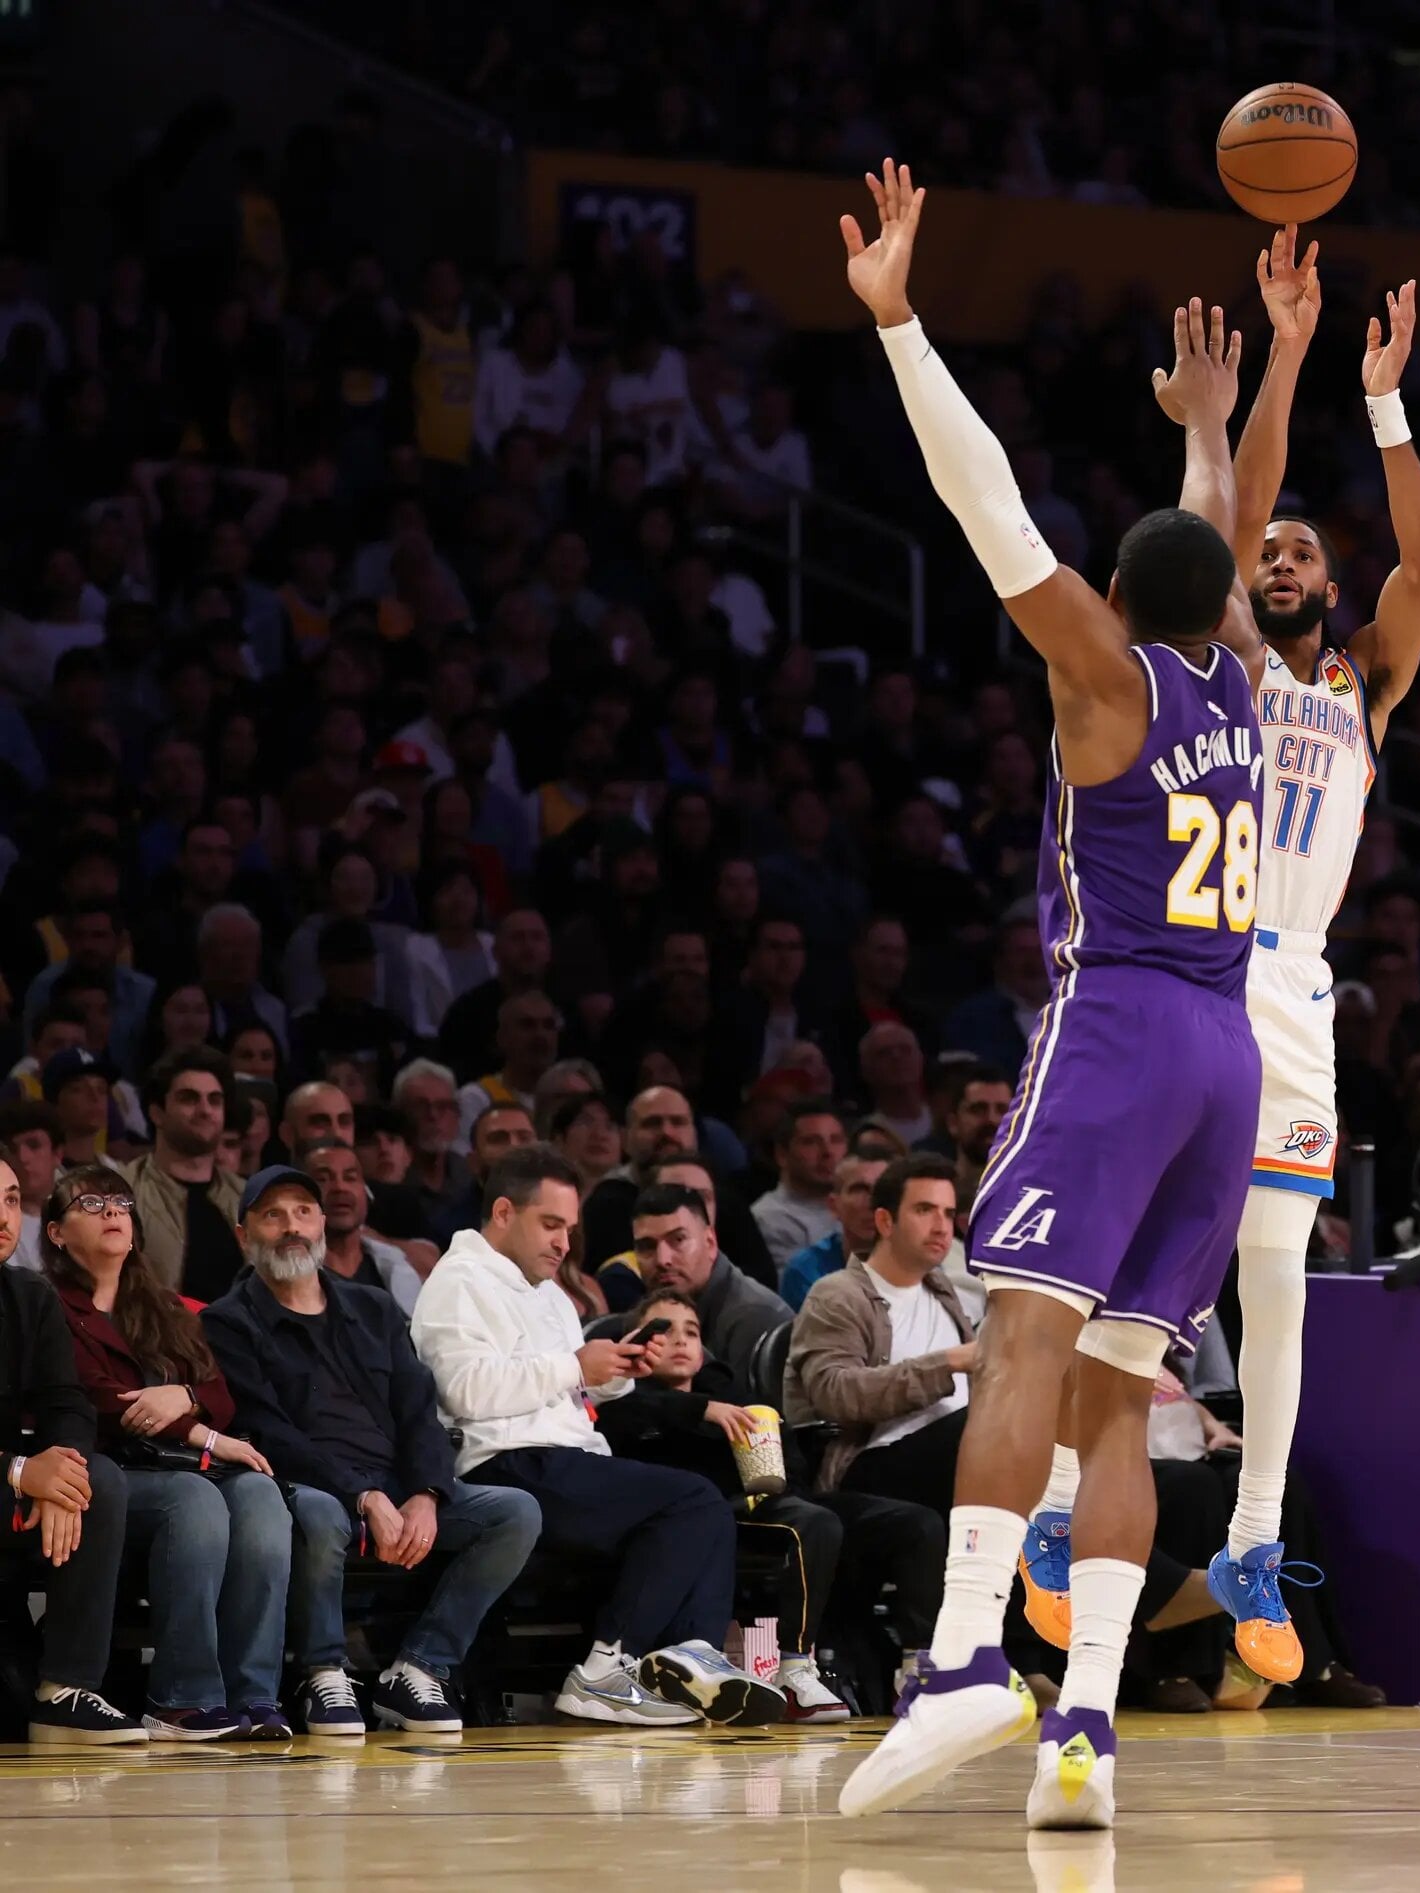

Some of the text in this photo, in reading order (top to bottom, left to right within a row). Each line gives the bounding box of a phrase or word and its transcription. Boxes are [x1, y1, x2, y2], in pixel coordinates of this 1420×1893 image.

[1241, 103, 1334, 131] Wilson
[1275, 734, 1336, 782] CITY
[1271, 777, 1326, 858] 11
[1166, 792, 1258, 933] 28
[1285, 1130, 1323, 1148] OKC
[982, 1186, 1056, 1251] LA
